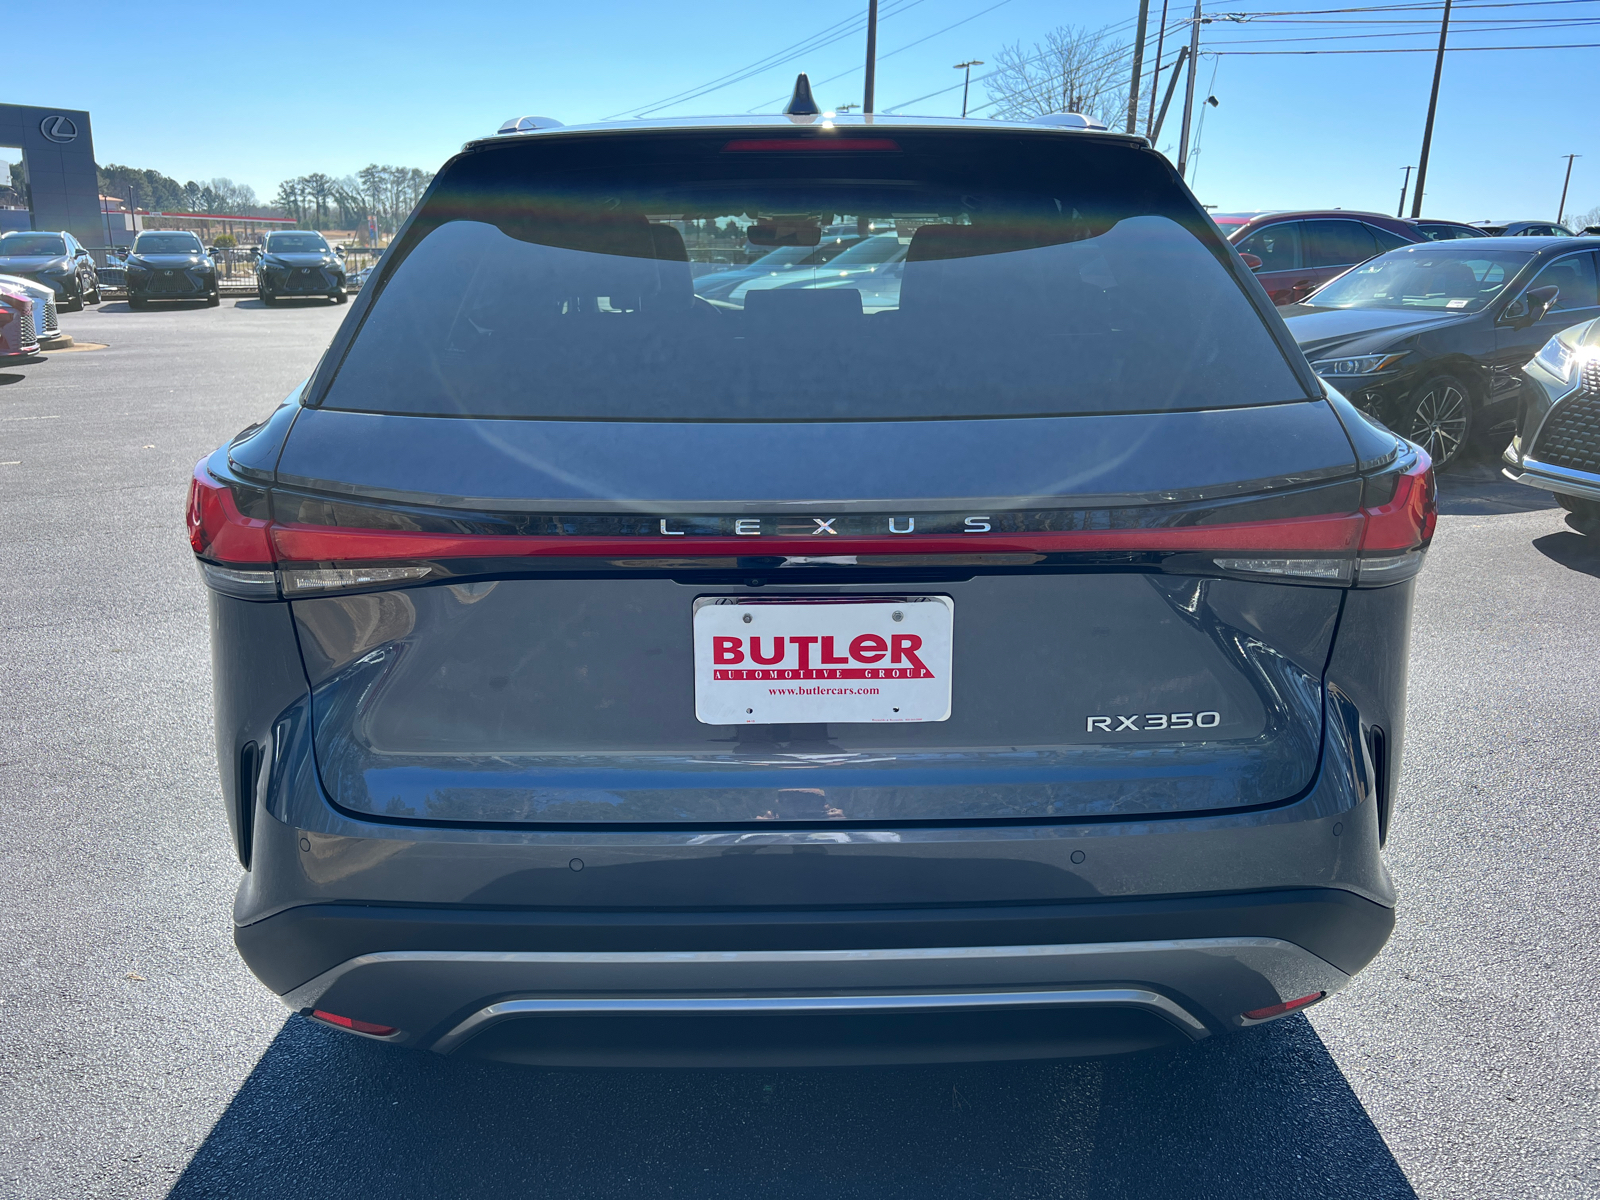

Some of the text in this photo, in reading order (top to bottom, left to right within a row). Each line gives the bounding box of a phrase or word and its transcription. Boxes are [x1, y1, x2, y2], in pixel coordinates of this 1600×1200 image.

[660, 516, 991, 535] LEXUS
[715, 668, 927, 679] AUTOMOTIVE GROUP
[768, 686, 880, 696] www.butlercars.com
